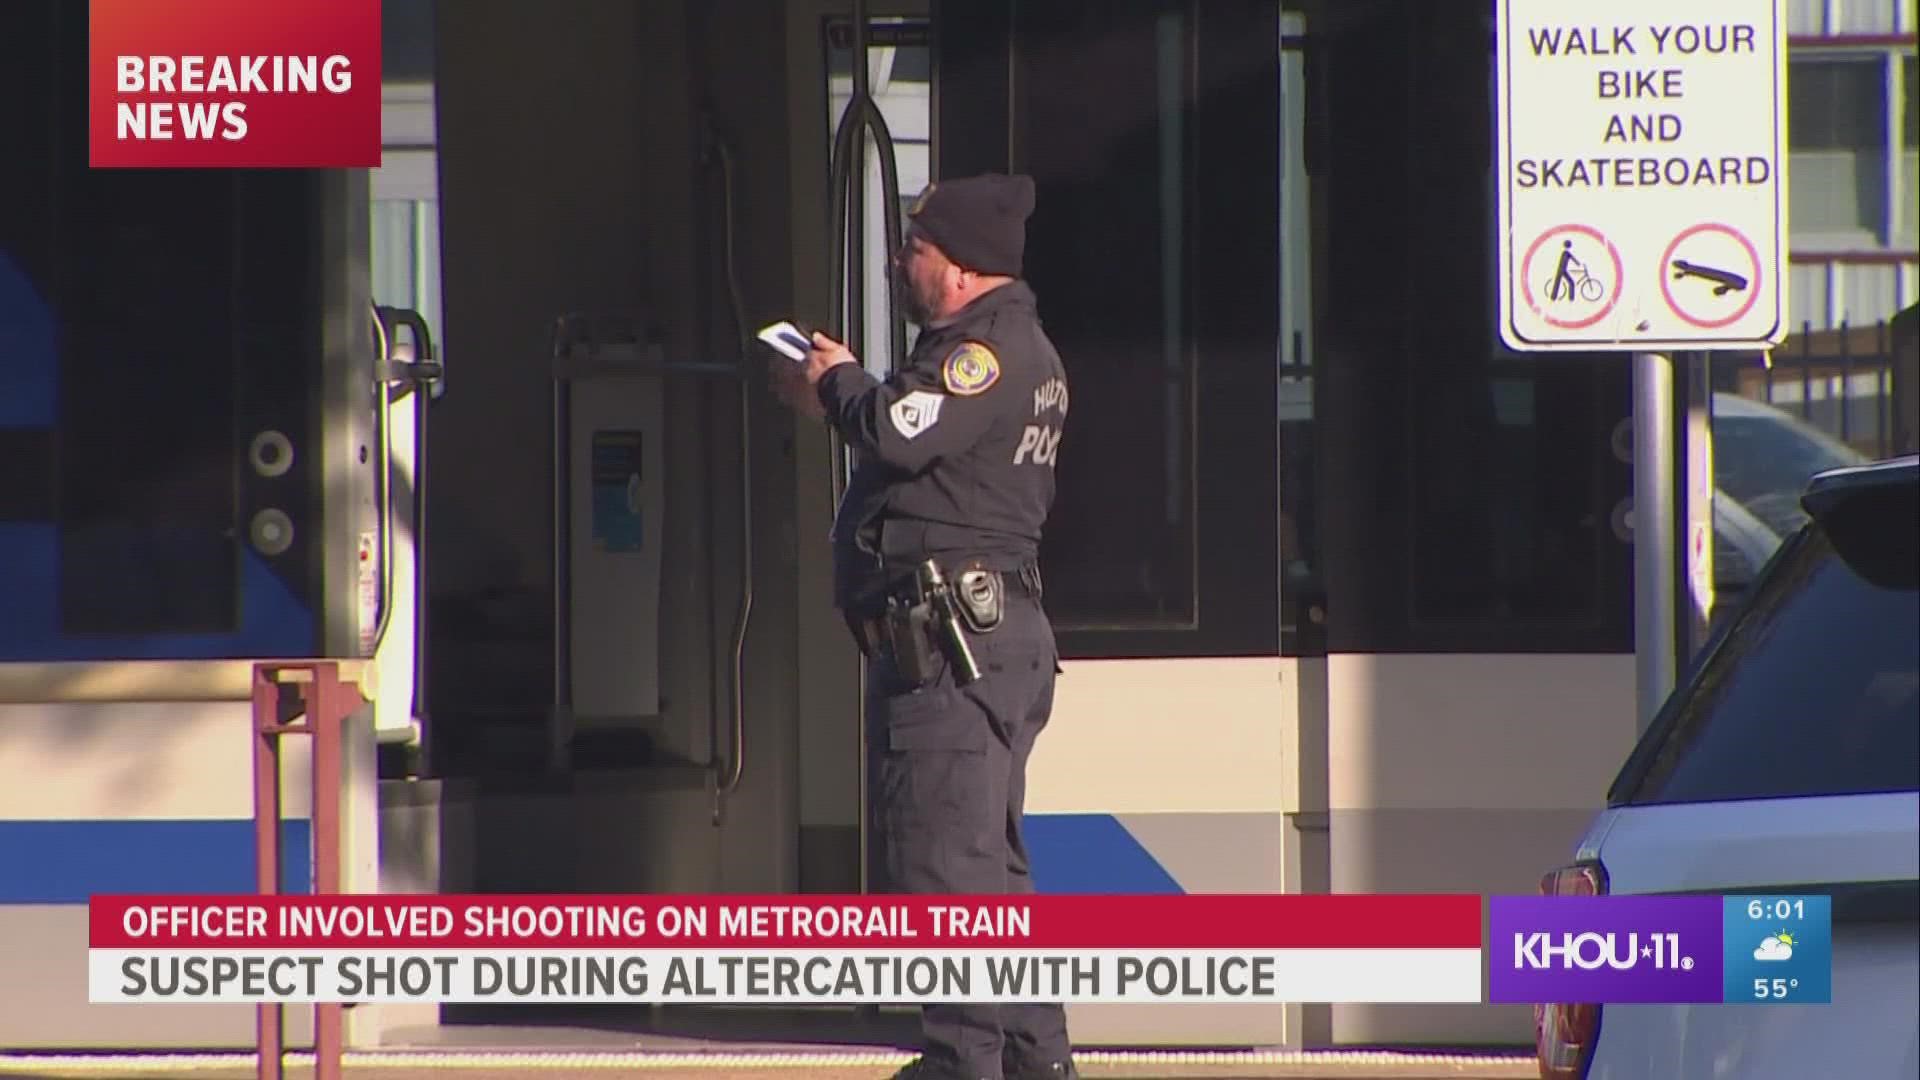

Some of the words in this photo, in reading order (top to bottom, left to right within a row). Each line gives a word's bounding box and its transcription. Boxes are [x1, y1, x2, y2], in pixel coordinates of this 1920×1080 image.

[1528, 26, 1636, 56] WALK
[1649, 25, 1755, 54] YOUR
[1598, 69, 1683, 99] BIKE
[1603, 114, 1682, 143] AND
[1516, 156, 1770, 188] SKATEBOARD
